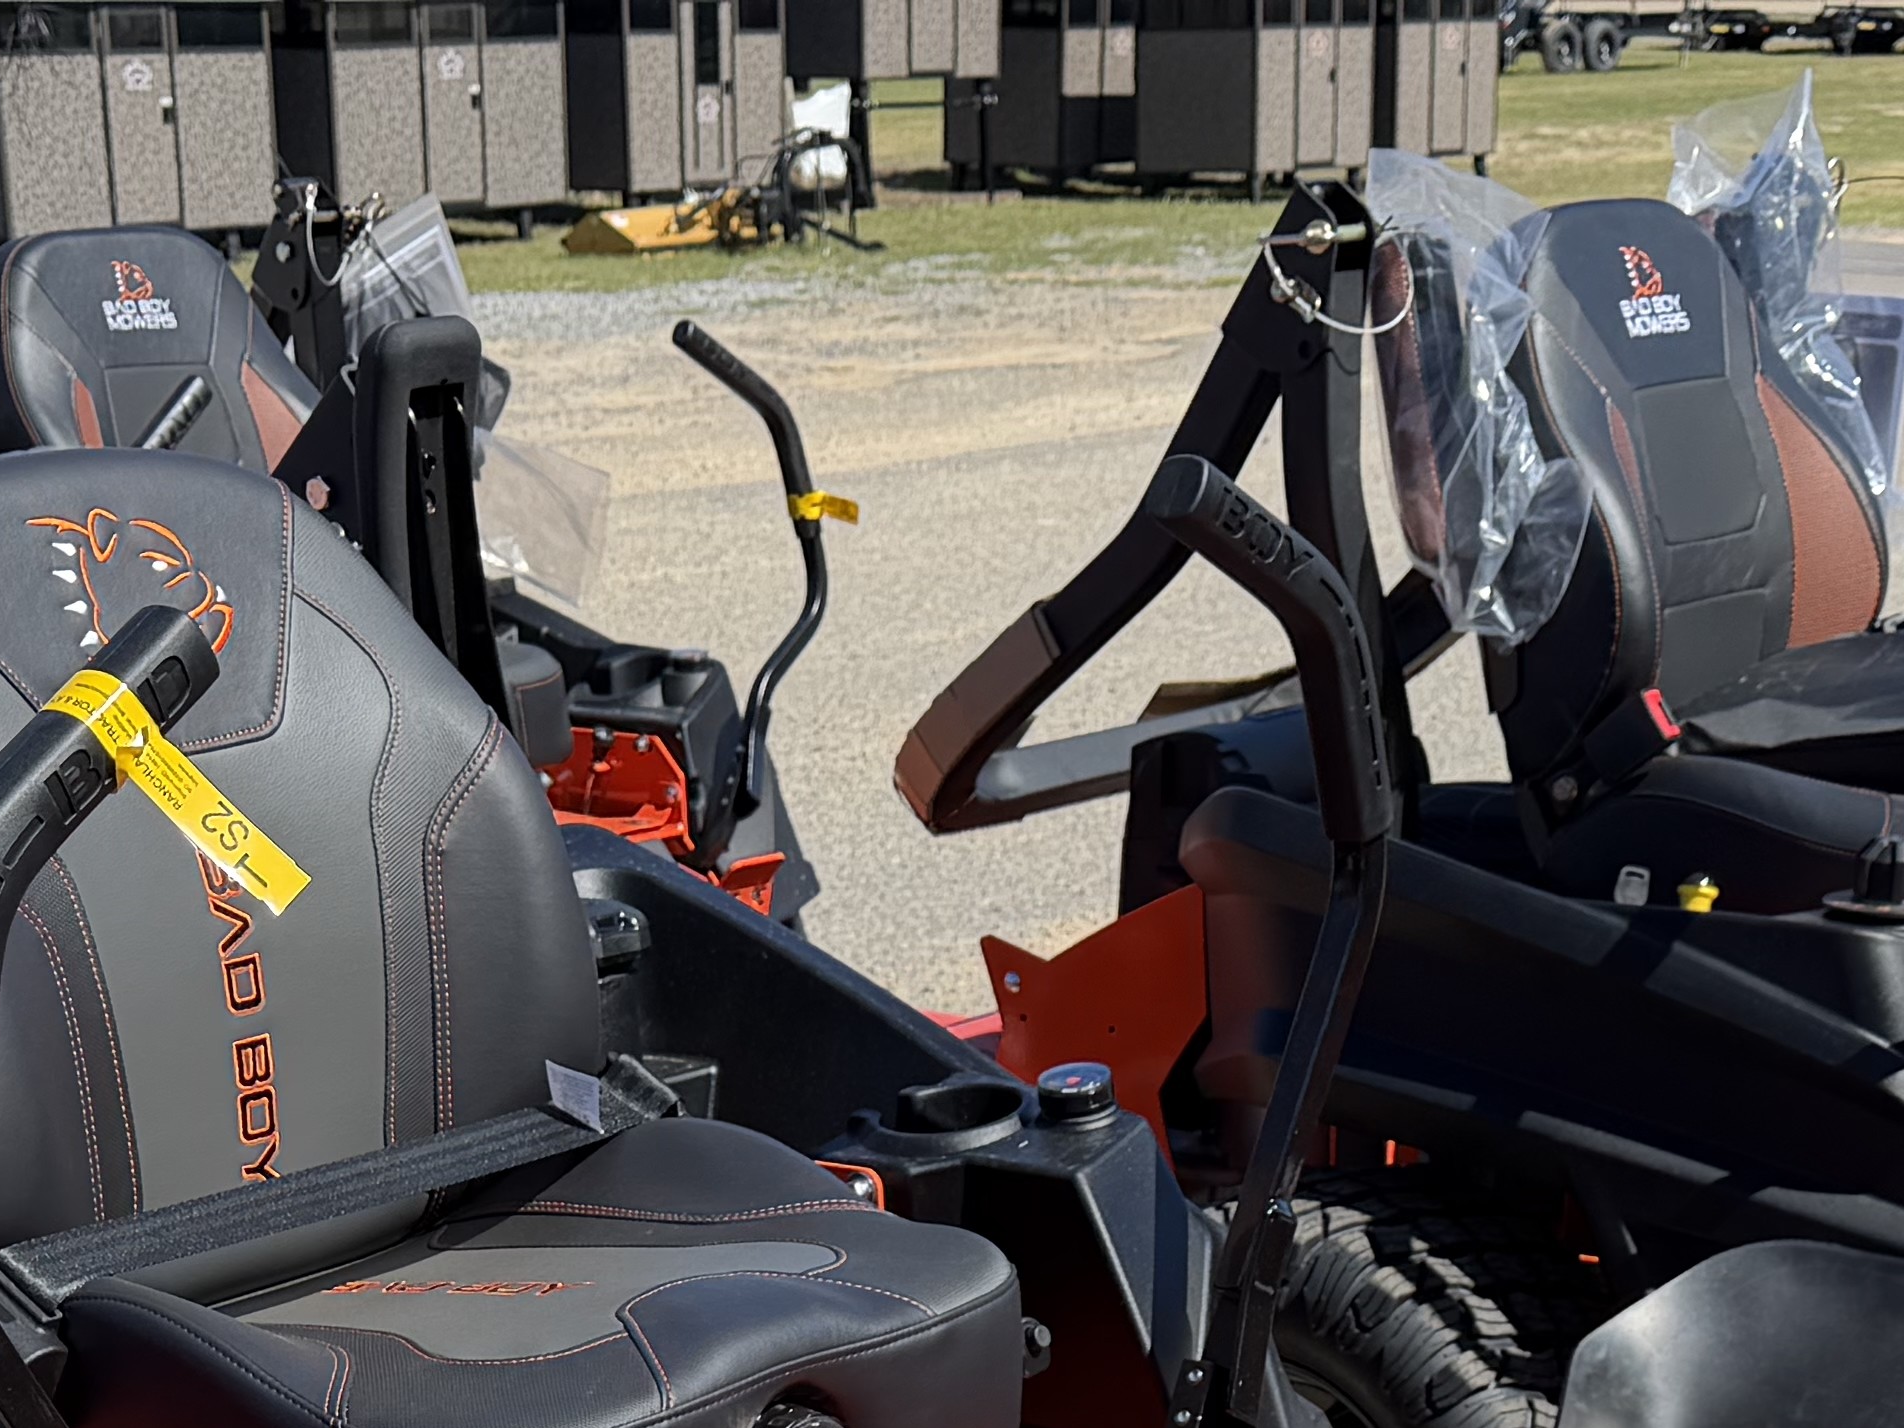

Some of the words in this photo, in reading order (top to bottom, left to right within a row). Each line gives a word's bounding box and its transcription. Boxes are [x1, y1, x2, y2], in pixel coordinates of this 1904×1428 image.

[102, 300, 137, 315] BAD
[137, 298, 171, 314] BOY
[1619, 296, 1653, 319] BAD
[1651, 293, 1682, 314] BOY
[106, 312, 178, 332] MOWERS
[1625, 311, 1691, 339] MOWERS
[1219, 485, 1314, 581] BOY
[200, 801, 250, 852] S2
